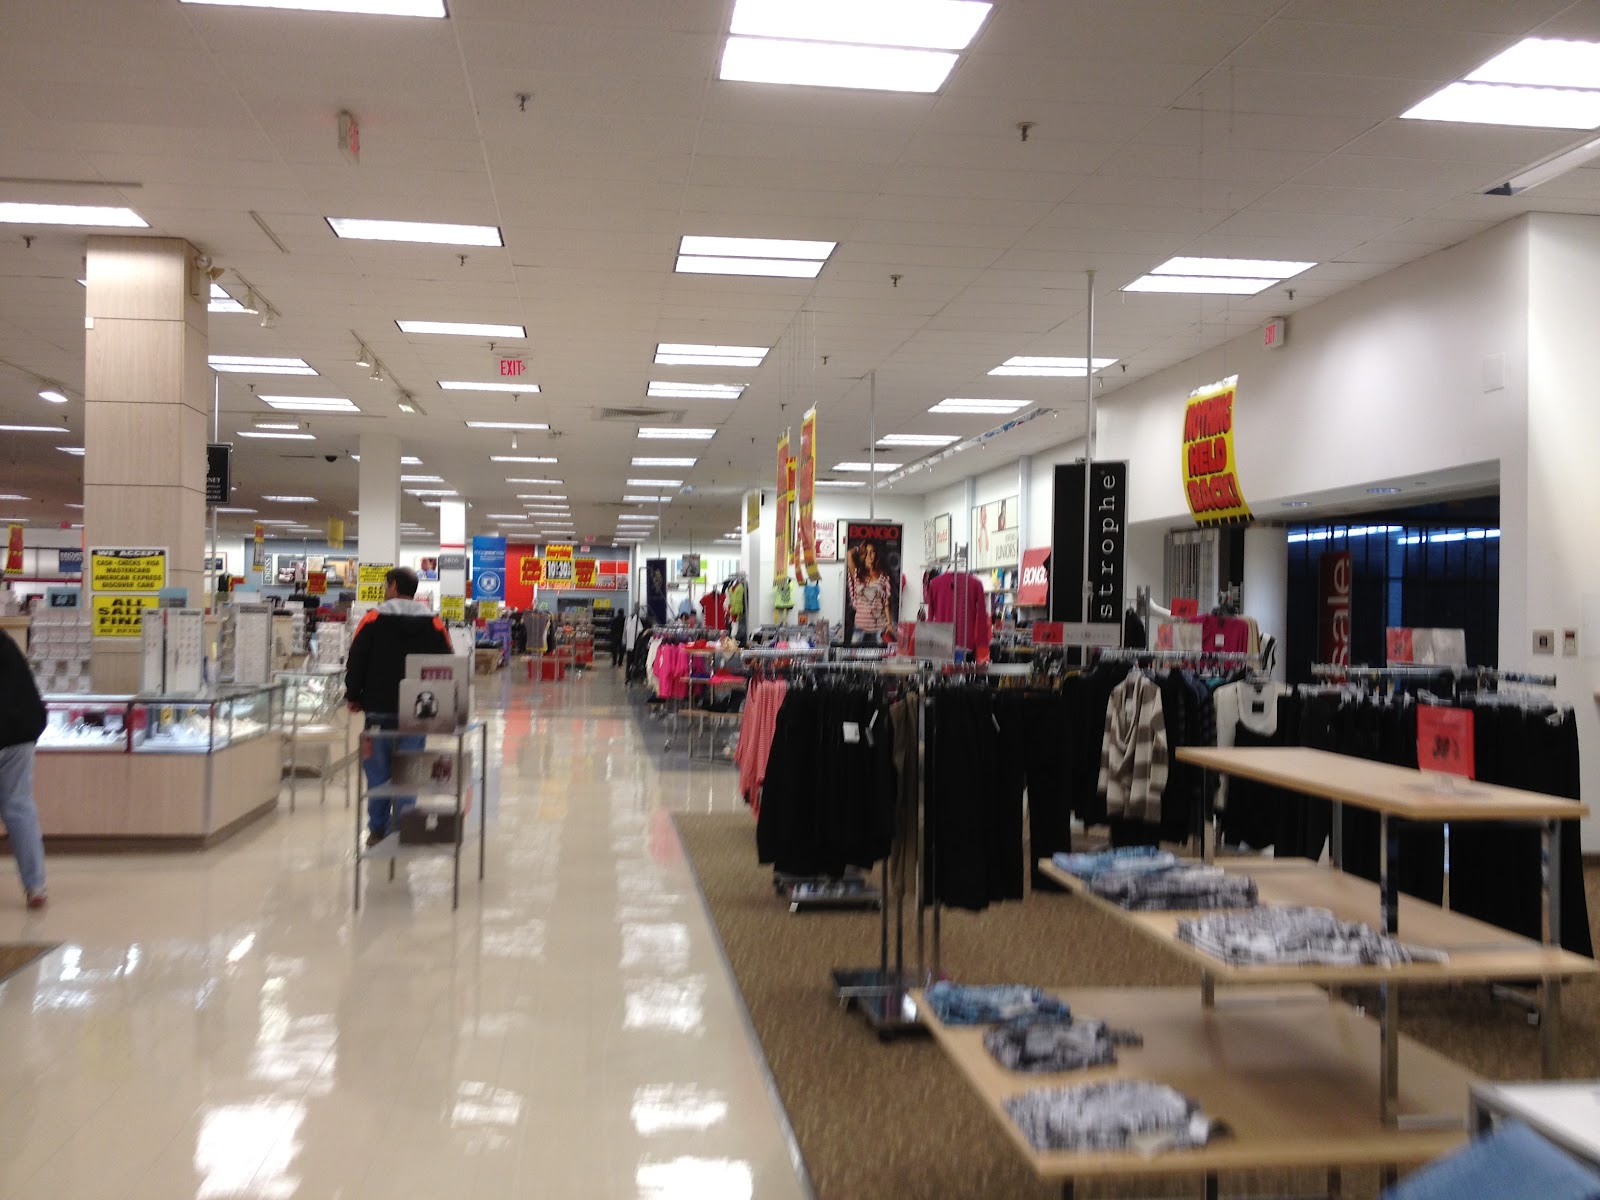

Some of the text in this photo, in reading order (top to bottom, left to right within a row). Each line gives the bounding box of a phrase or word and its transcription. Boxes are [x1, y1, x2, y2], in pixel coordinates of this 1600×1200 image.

[1265, 324, 1276, 345] EXIT
[500, 360, 522, 376] EXIT
[1184, 391, 1233, 444] NOTHING
[1188, 436, 1227, 478] HELD
[1187, 472, 1242, 514] BACK!
[849, 526, 899, 540] BONGO
[1099, 475, 1119, 619] strophe
[112, 599, 146, 607] ALL
[100, 617, 142, 625] FINA
